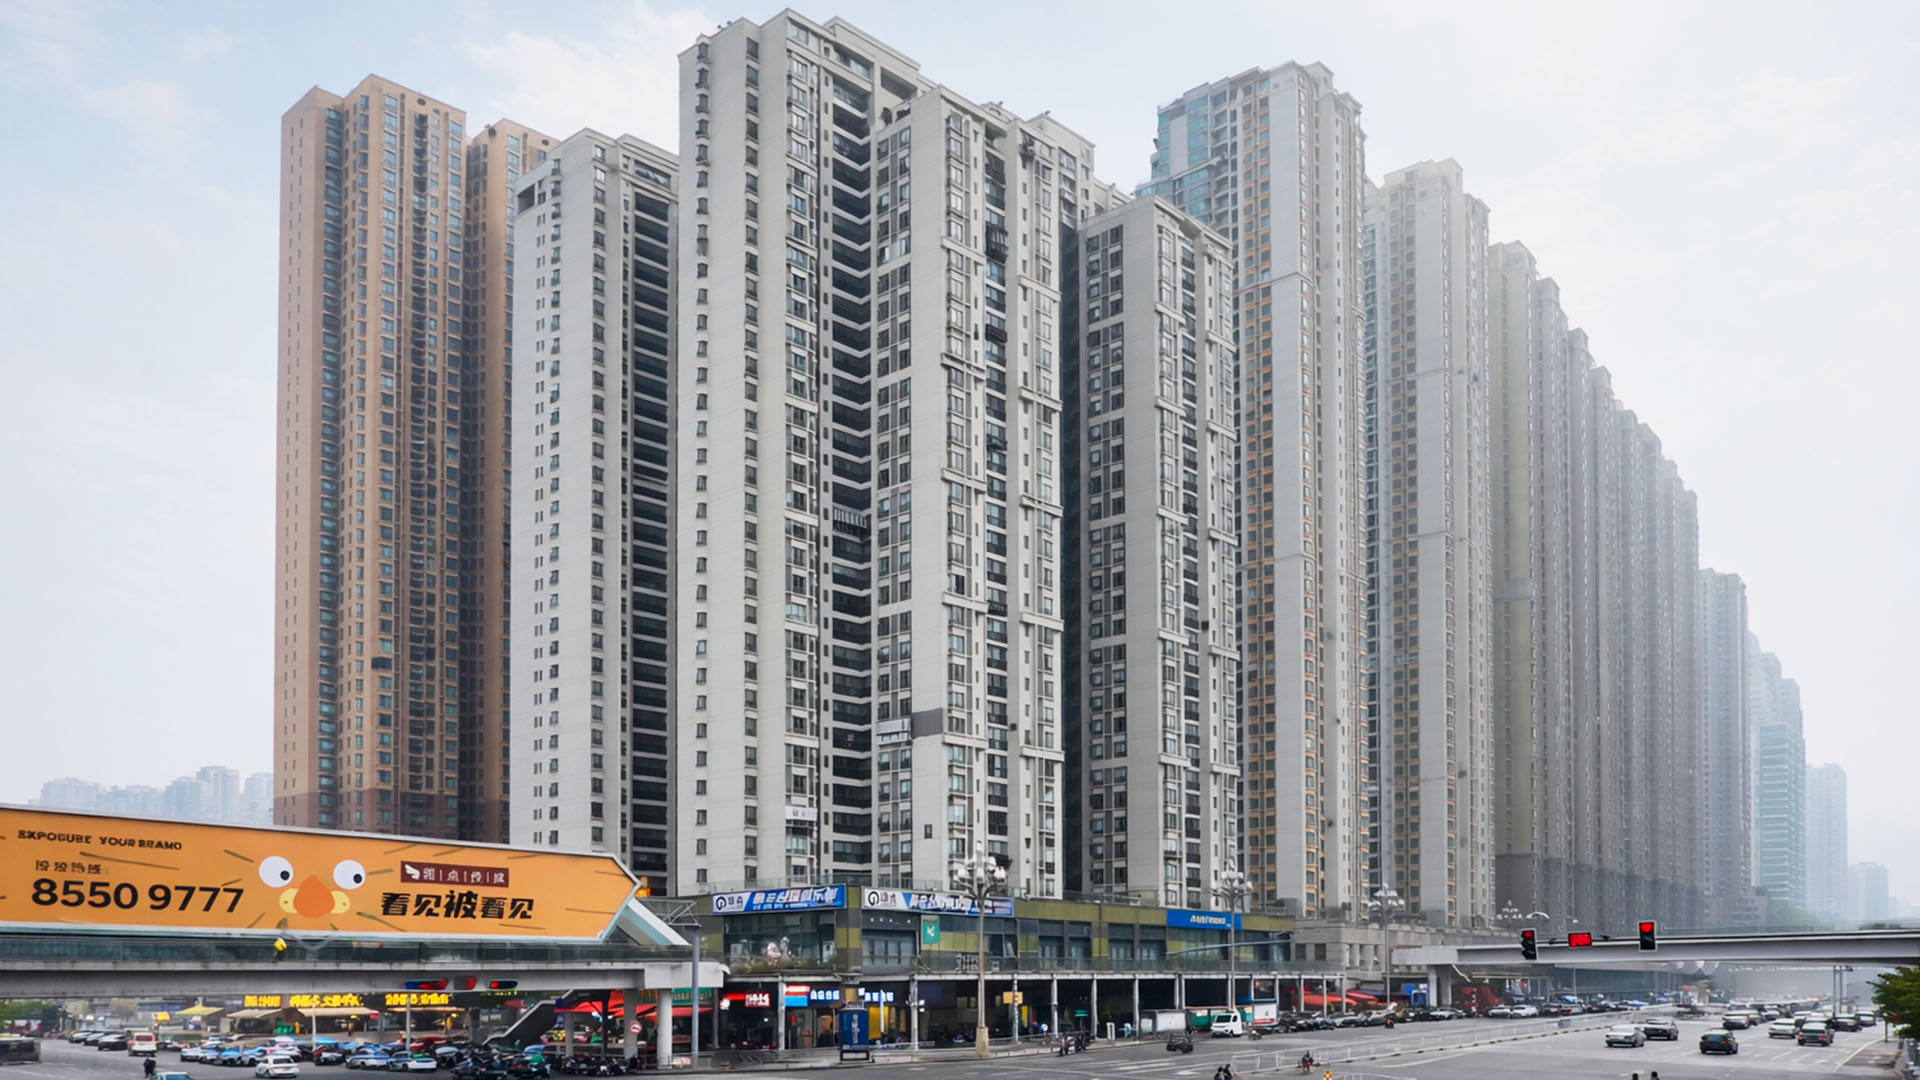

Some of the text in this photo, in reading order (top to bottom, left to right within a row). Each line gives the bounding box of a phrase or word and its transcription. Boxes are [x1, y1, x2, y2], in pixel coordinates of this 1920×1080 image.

[99, 836, 136, 847] YOUR
[32, 878, 244, 913] 8550 9777
[381, 890, 534, 919] 看见被看见
